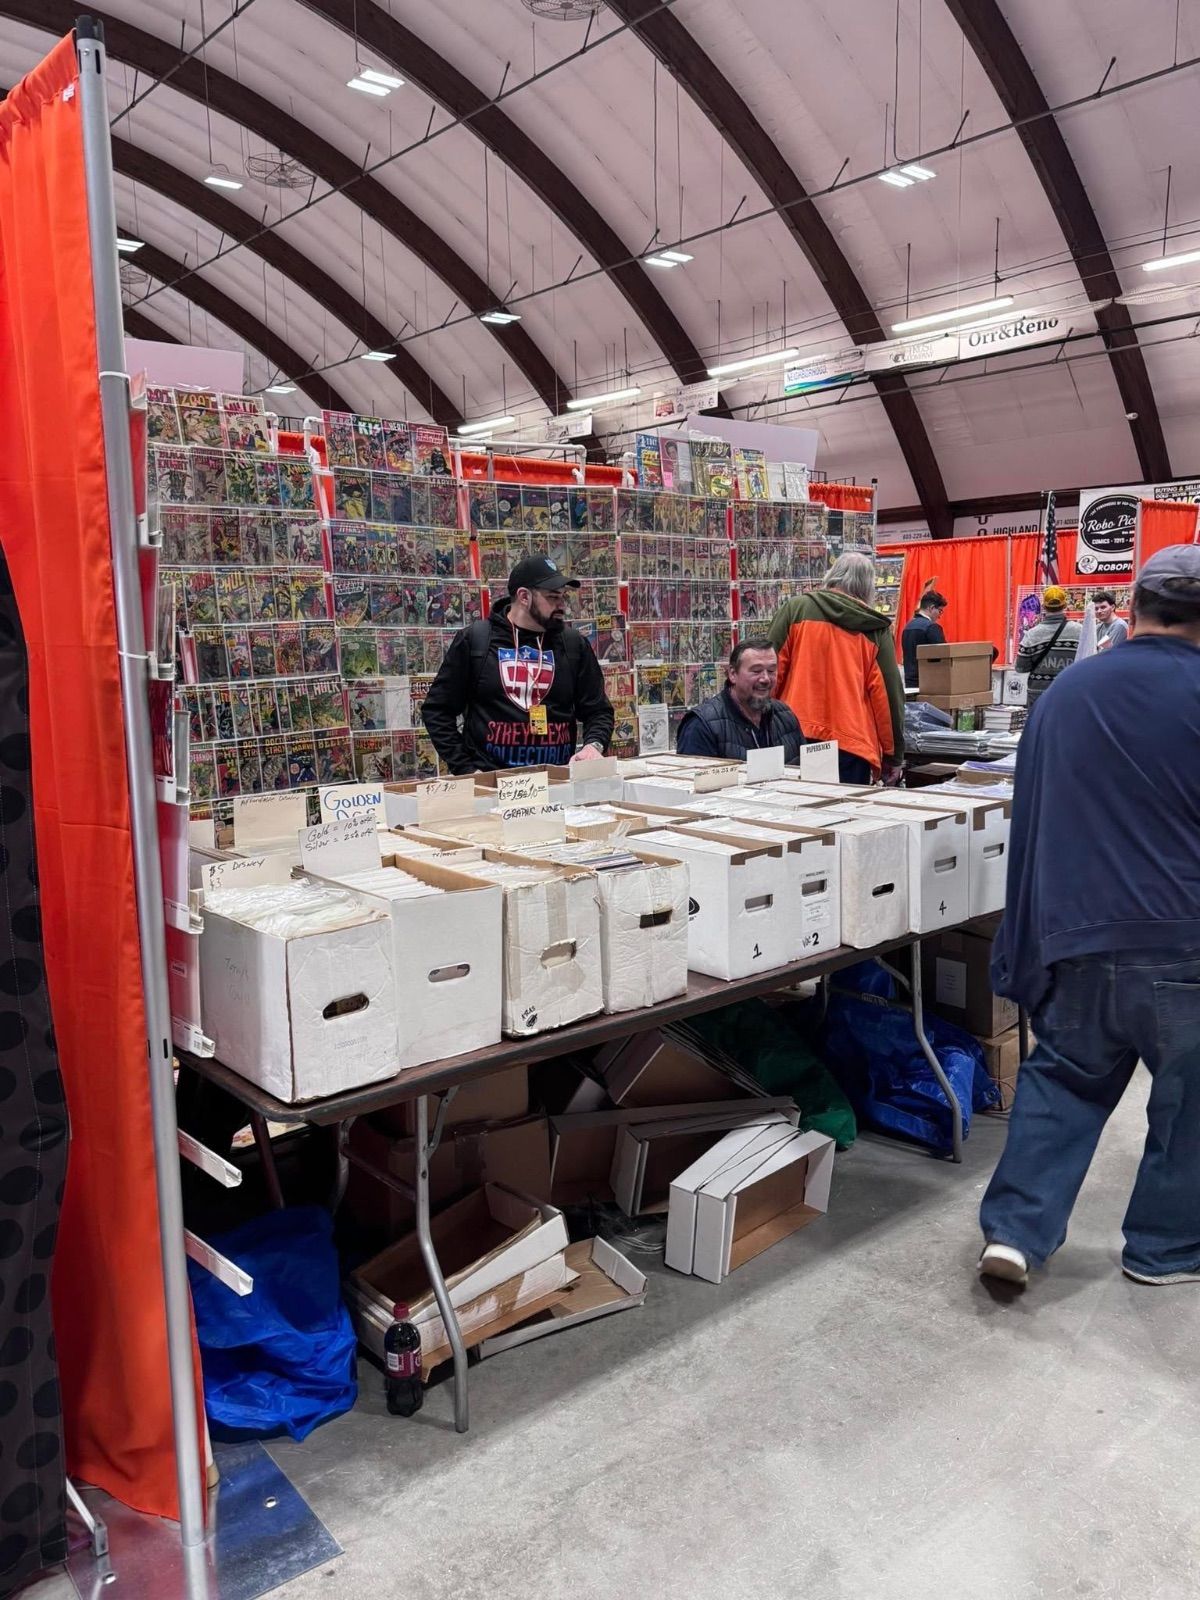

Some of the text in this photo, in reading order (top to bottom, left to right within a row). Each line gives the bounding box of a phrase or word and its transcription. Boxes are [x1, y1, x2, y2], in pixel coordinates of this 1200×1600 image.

[968, 316, 1059, 347] Orr&Reno
[993, 524, 1038, 536] HIGHLAND
[1087, 517, 1115, 532] Robo
[324, 790, 381, 811] GOLDEN
[503, 803, 565, 820] GRAPHIC NOVEL
[308, 824, 330, 842] Gold
[938, 900, 947, 916] 4
[812, 932, 820, 946] 2
[752, 943, 762, 959] 1
